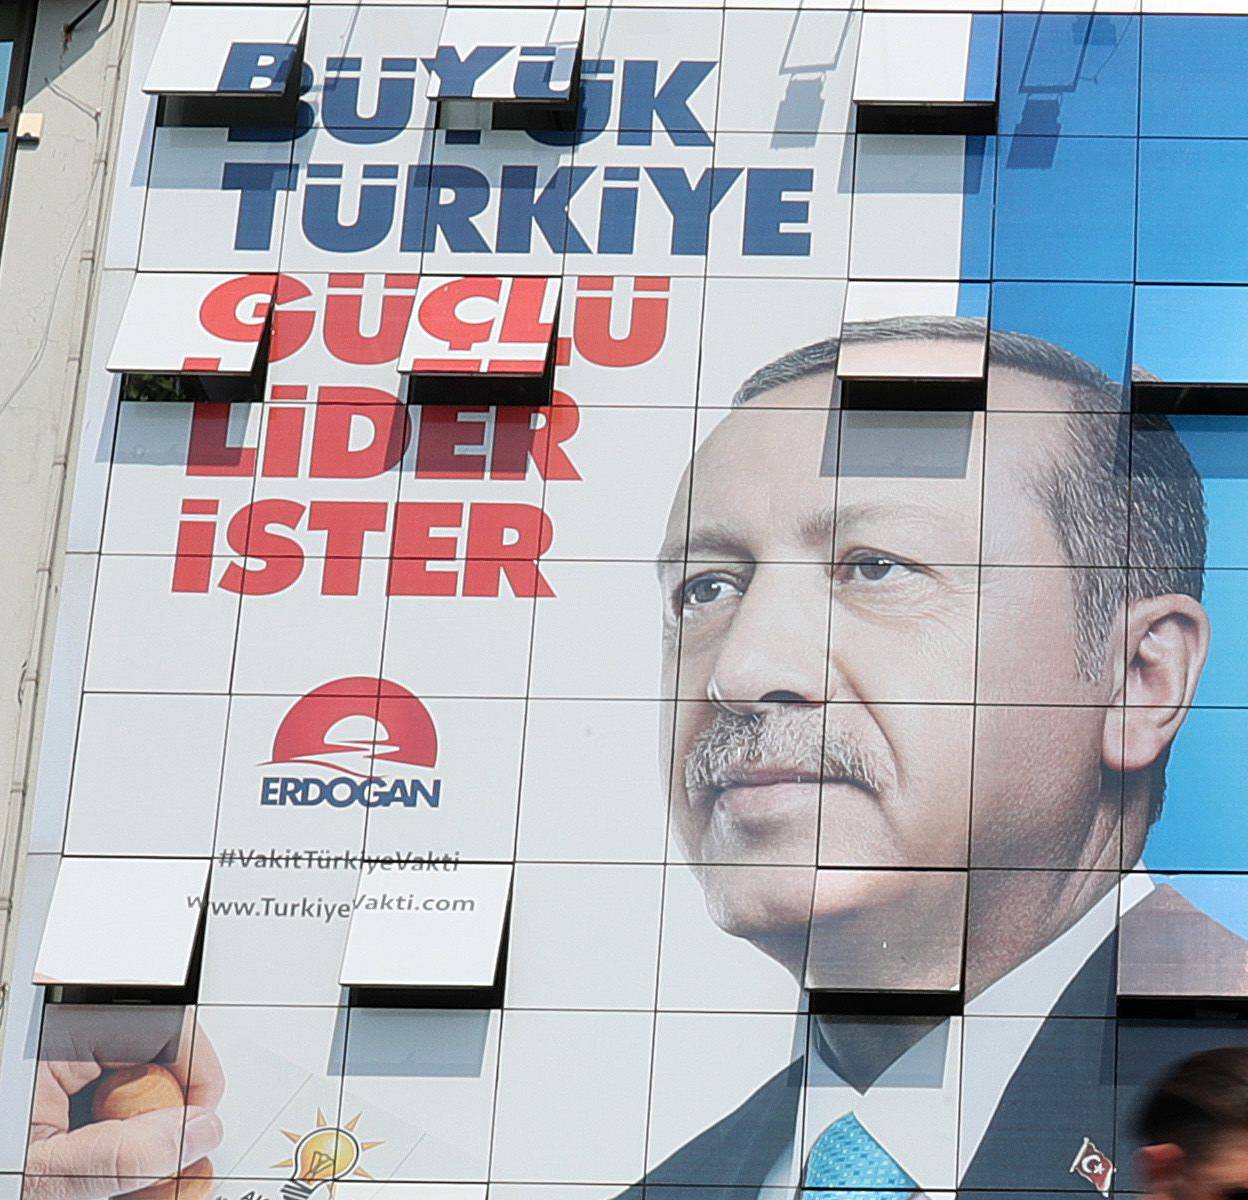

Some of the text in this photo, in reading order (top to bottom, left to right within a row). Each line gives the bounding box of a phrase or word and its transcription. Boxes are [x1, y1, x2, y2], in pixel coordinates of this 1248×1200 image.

[217, 42, 718, 146] BÜYÜK
[222, 162, 814, 256] TÜRKİYE
[199, 273, 670, 367] GÜÇLÜ
[184, 384, 583, 480] LİDER
[171, 498, 557, 598] İSTER
[187, 894, 475, 922] www.TurkiyeVakti.com
[218, 848, 460, 874] #VakitTürkiyeVakti
